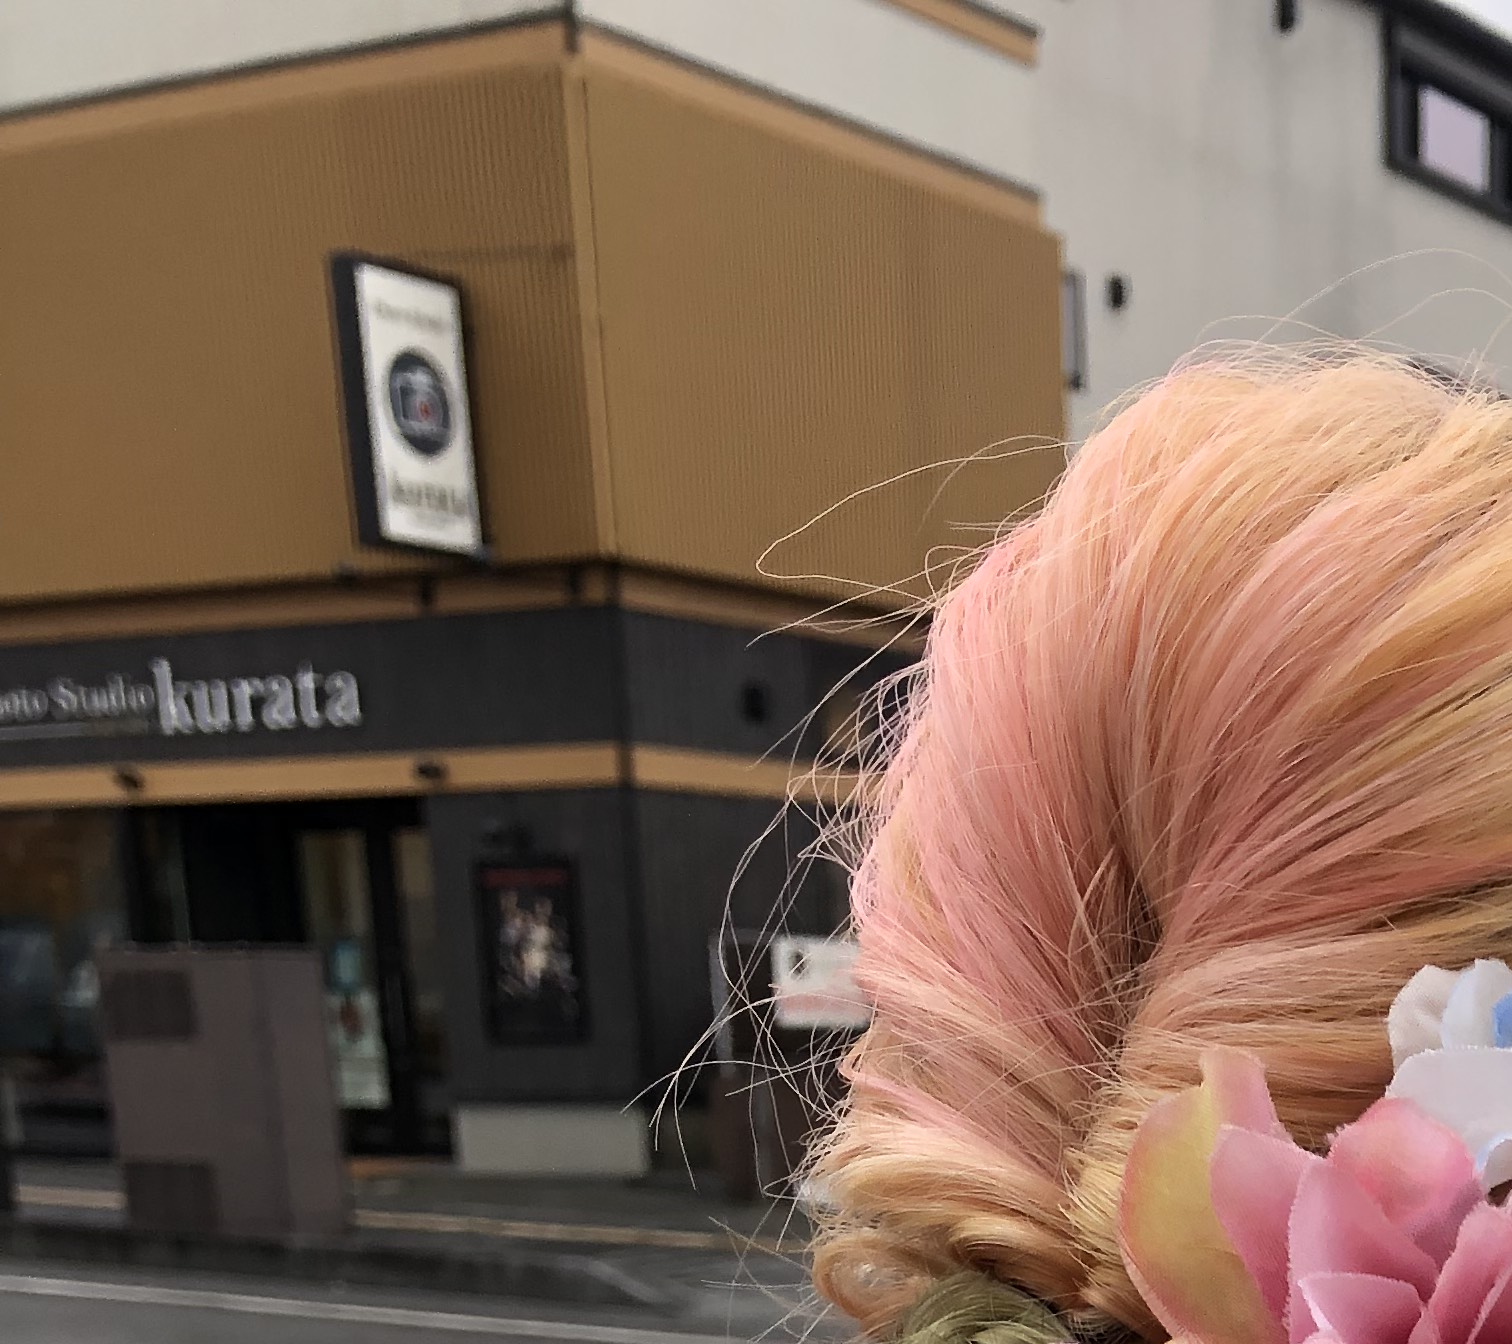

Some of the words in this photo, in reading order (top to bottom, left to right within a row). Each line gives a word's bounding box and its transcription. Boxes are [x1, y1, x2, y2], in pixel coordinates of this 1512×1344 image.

[0, 688, 49, 721] oto
[48, 674, 154, 719] Studio
[149, 656, 363, 736] kurata
